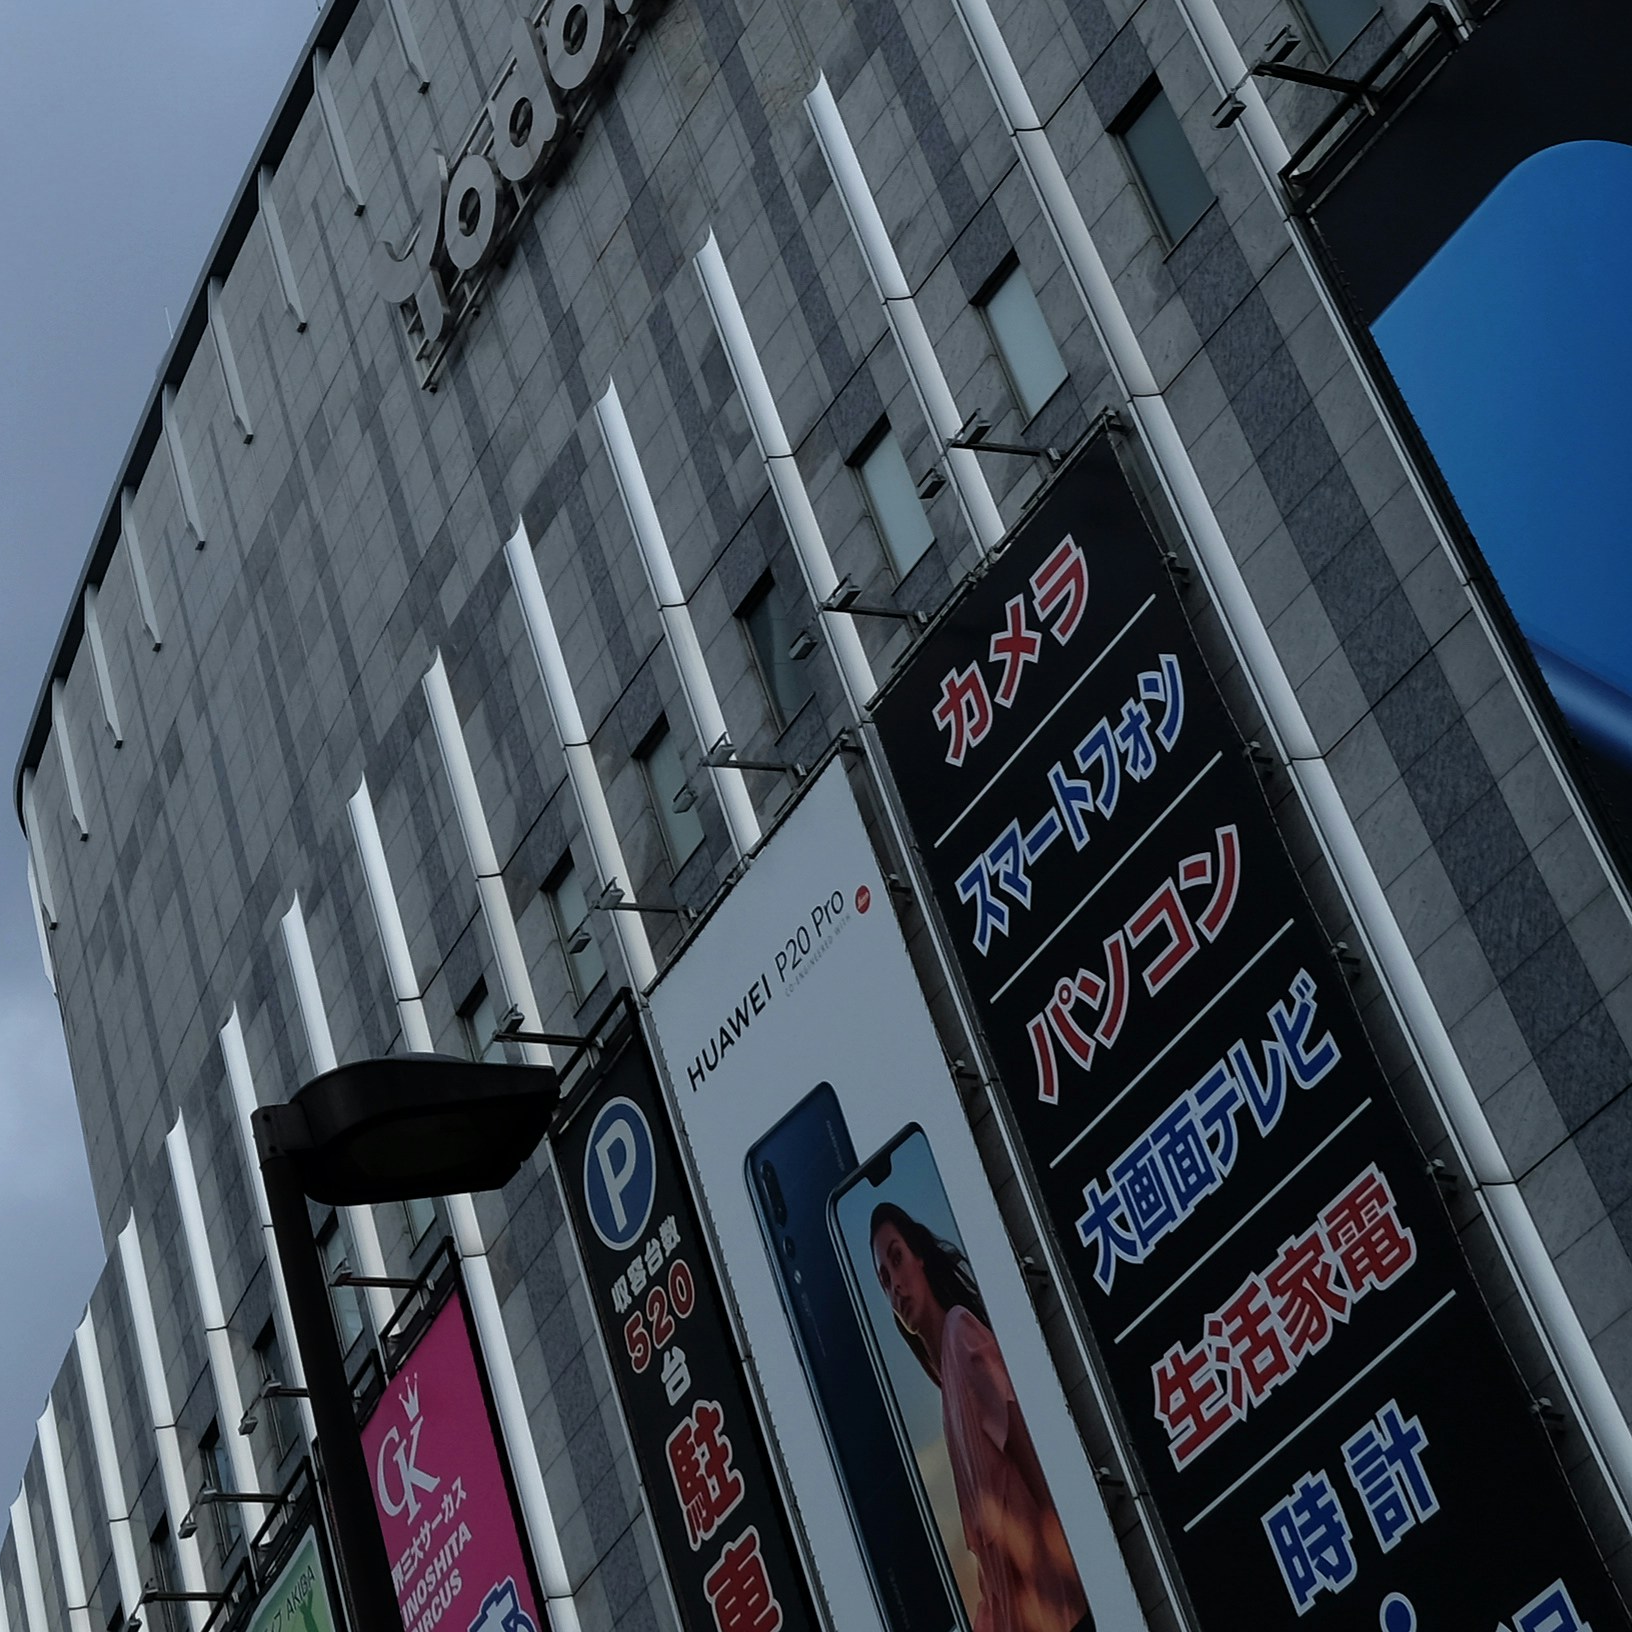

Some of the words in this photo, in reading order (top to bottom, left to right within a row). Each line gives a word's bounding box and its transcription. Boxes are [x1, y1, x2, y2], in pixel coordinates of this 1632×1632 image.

[932, 533, 1089, 768] カメラ
[954, 653, 1185, 957] スマートフォン
[686, 973, 773, 1093] HUAWEI
[774, 925, 811, 983] P20
[810, 890, 845, 938] Pro
[1025, 824, 1241, 1106] パソコン
[595, 1118, 637, 1233] P
[1074, 967, 1342, 1296] 大画面テレビ
[623, 1258, 695, 1374] 520
[1150, 1161, 1418, 1473] 生活家電
[400, 1521, 472, 1631] INOSHITA
[1260, 1397, 1441, 1618] 時計
